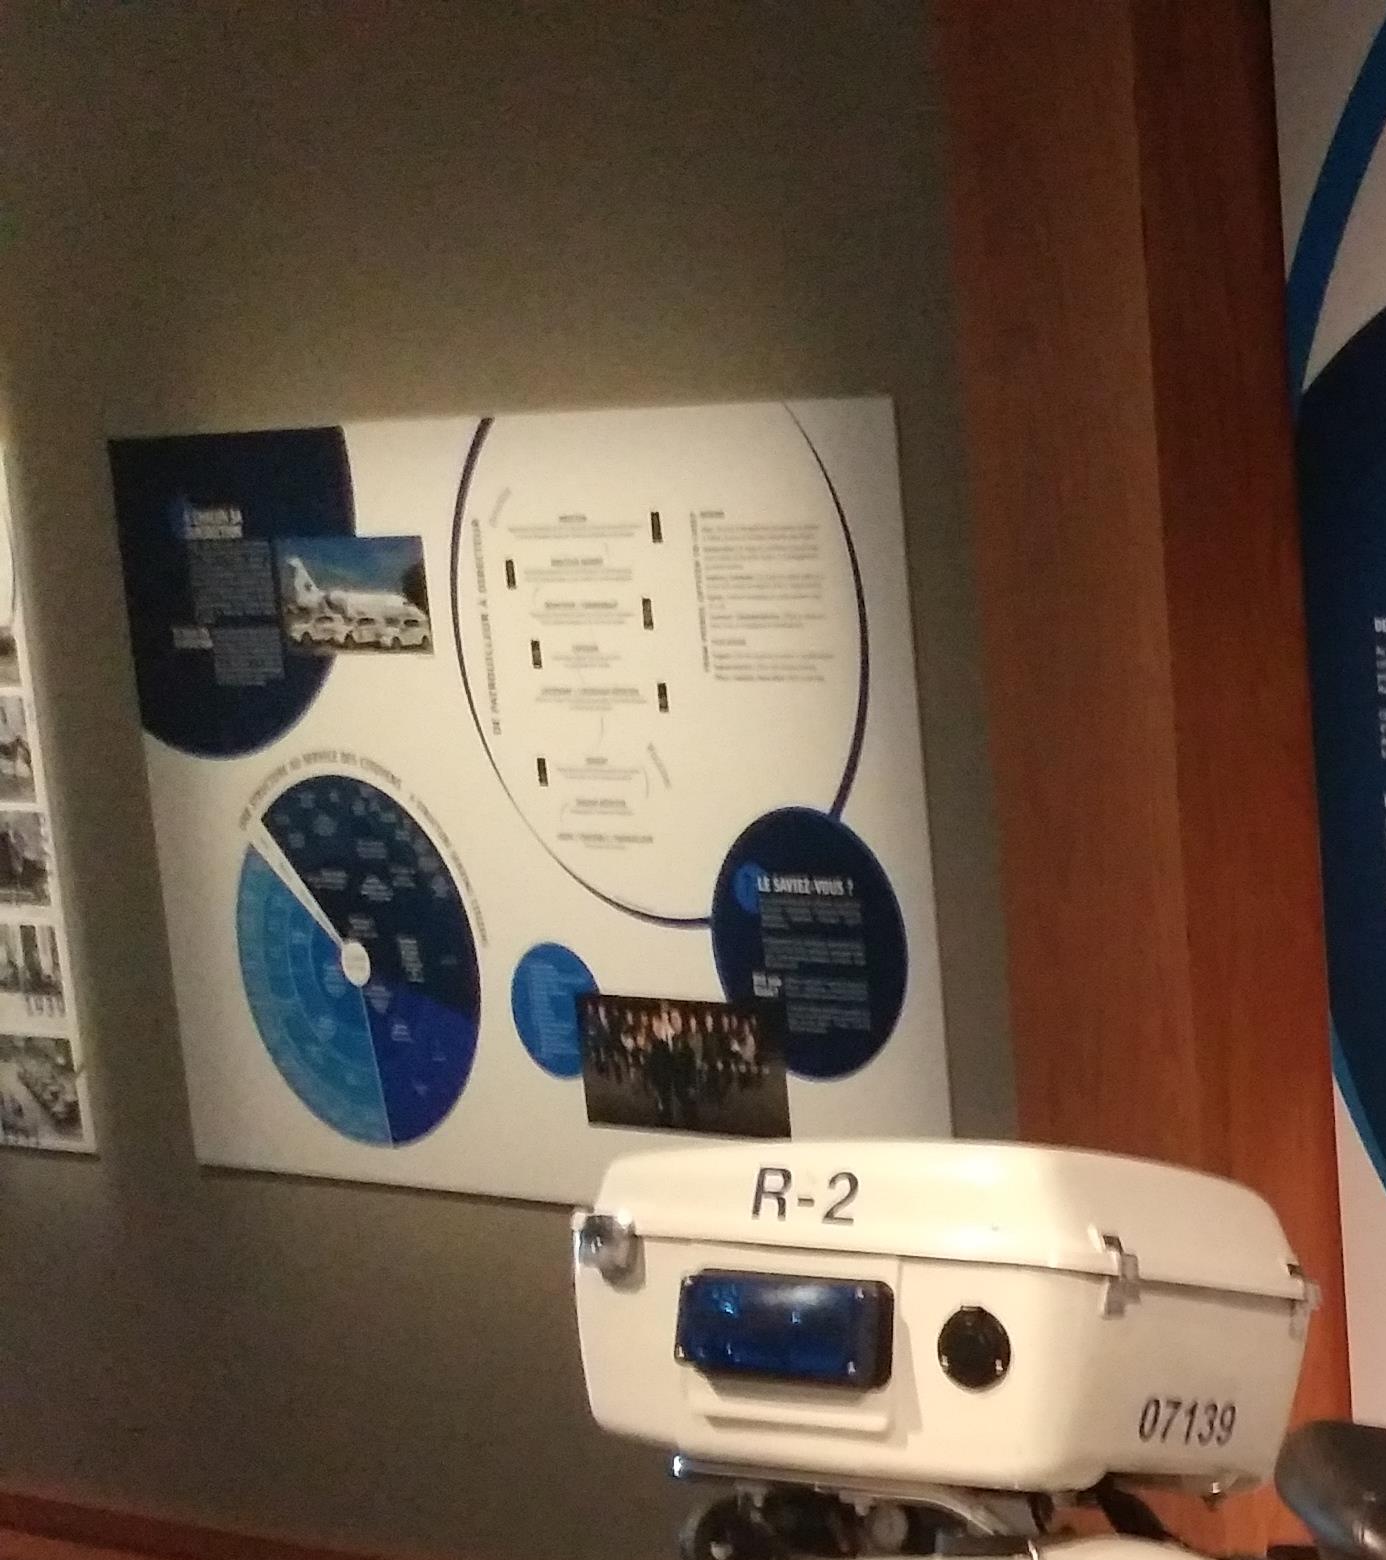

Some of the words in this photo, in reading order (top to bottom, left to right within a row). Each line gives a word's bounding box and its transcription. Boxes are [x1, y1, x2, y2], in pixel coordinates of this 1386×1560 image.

[757, 876, 771, 892] LE
[752, 1166, 860, 1226] R-2
[1138, 1397, 1238, 1448] 07139
